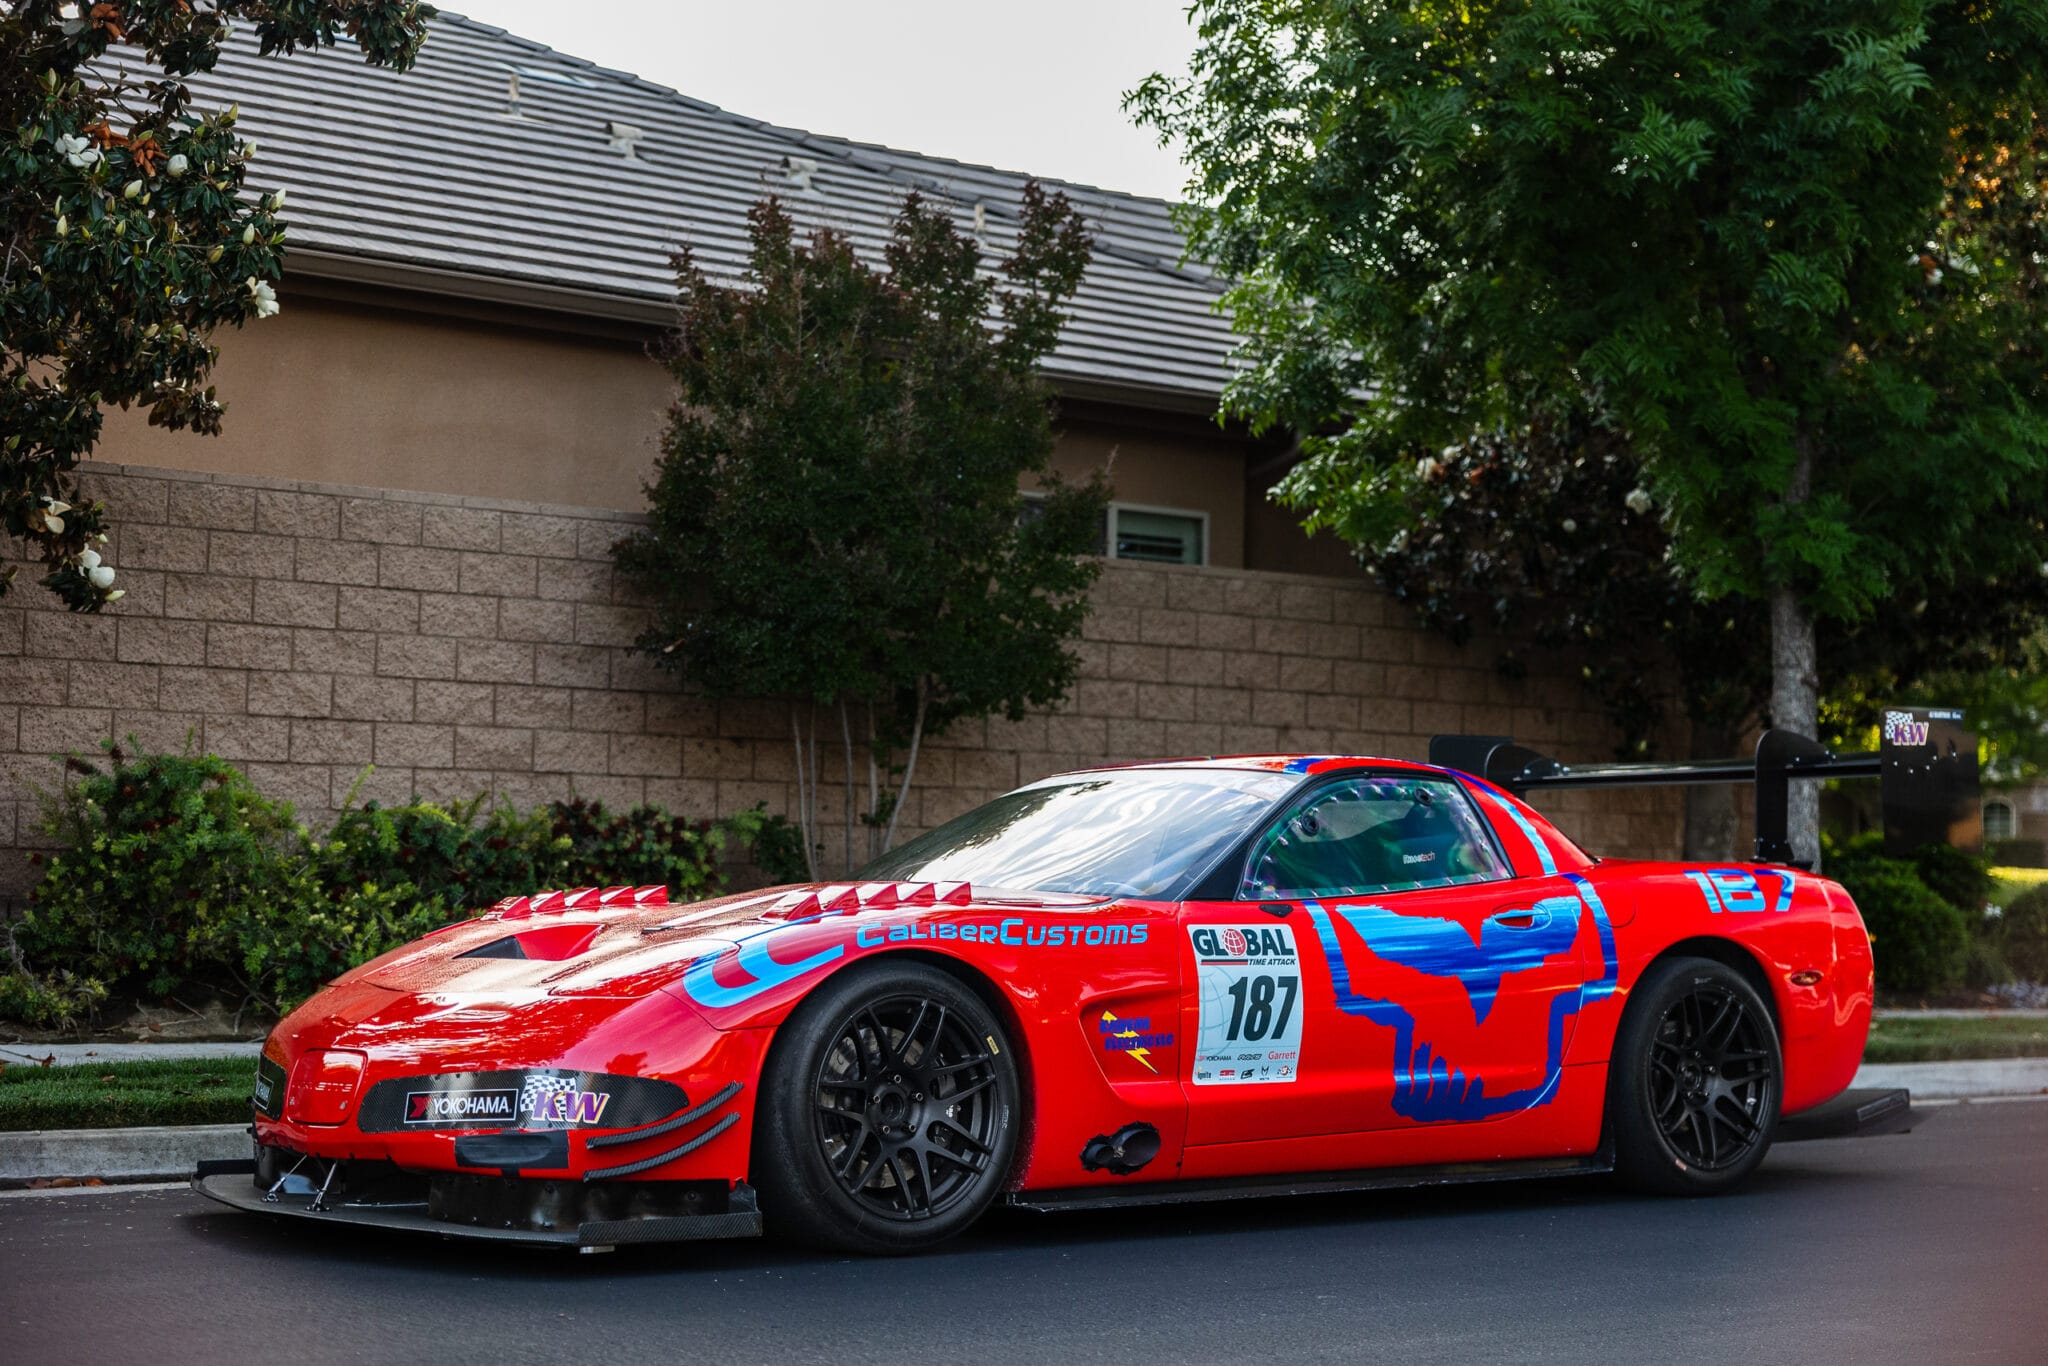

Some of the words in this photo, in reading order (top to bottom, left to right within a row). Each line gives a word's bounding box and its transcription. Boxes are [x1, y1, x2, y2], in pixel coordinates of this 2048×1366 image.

[1893, 721, 1929, 746] KW
[1683, 869, 1796, 914] 187
[1192, 928, 1295, 956] GLOBAL
[1267, 958, 1297, 966] ATTACK
[1226, 974, 1299, 1042] 187
[1268, 1051, 1296, 1060] Garrett
[433, 1095, 510, 1115] YOKOHAMA
[531, 1090, 611, 1124] KW
